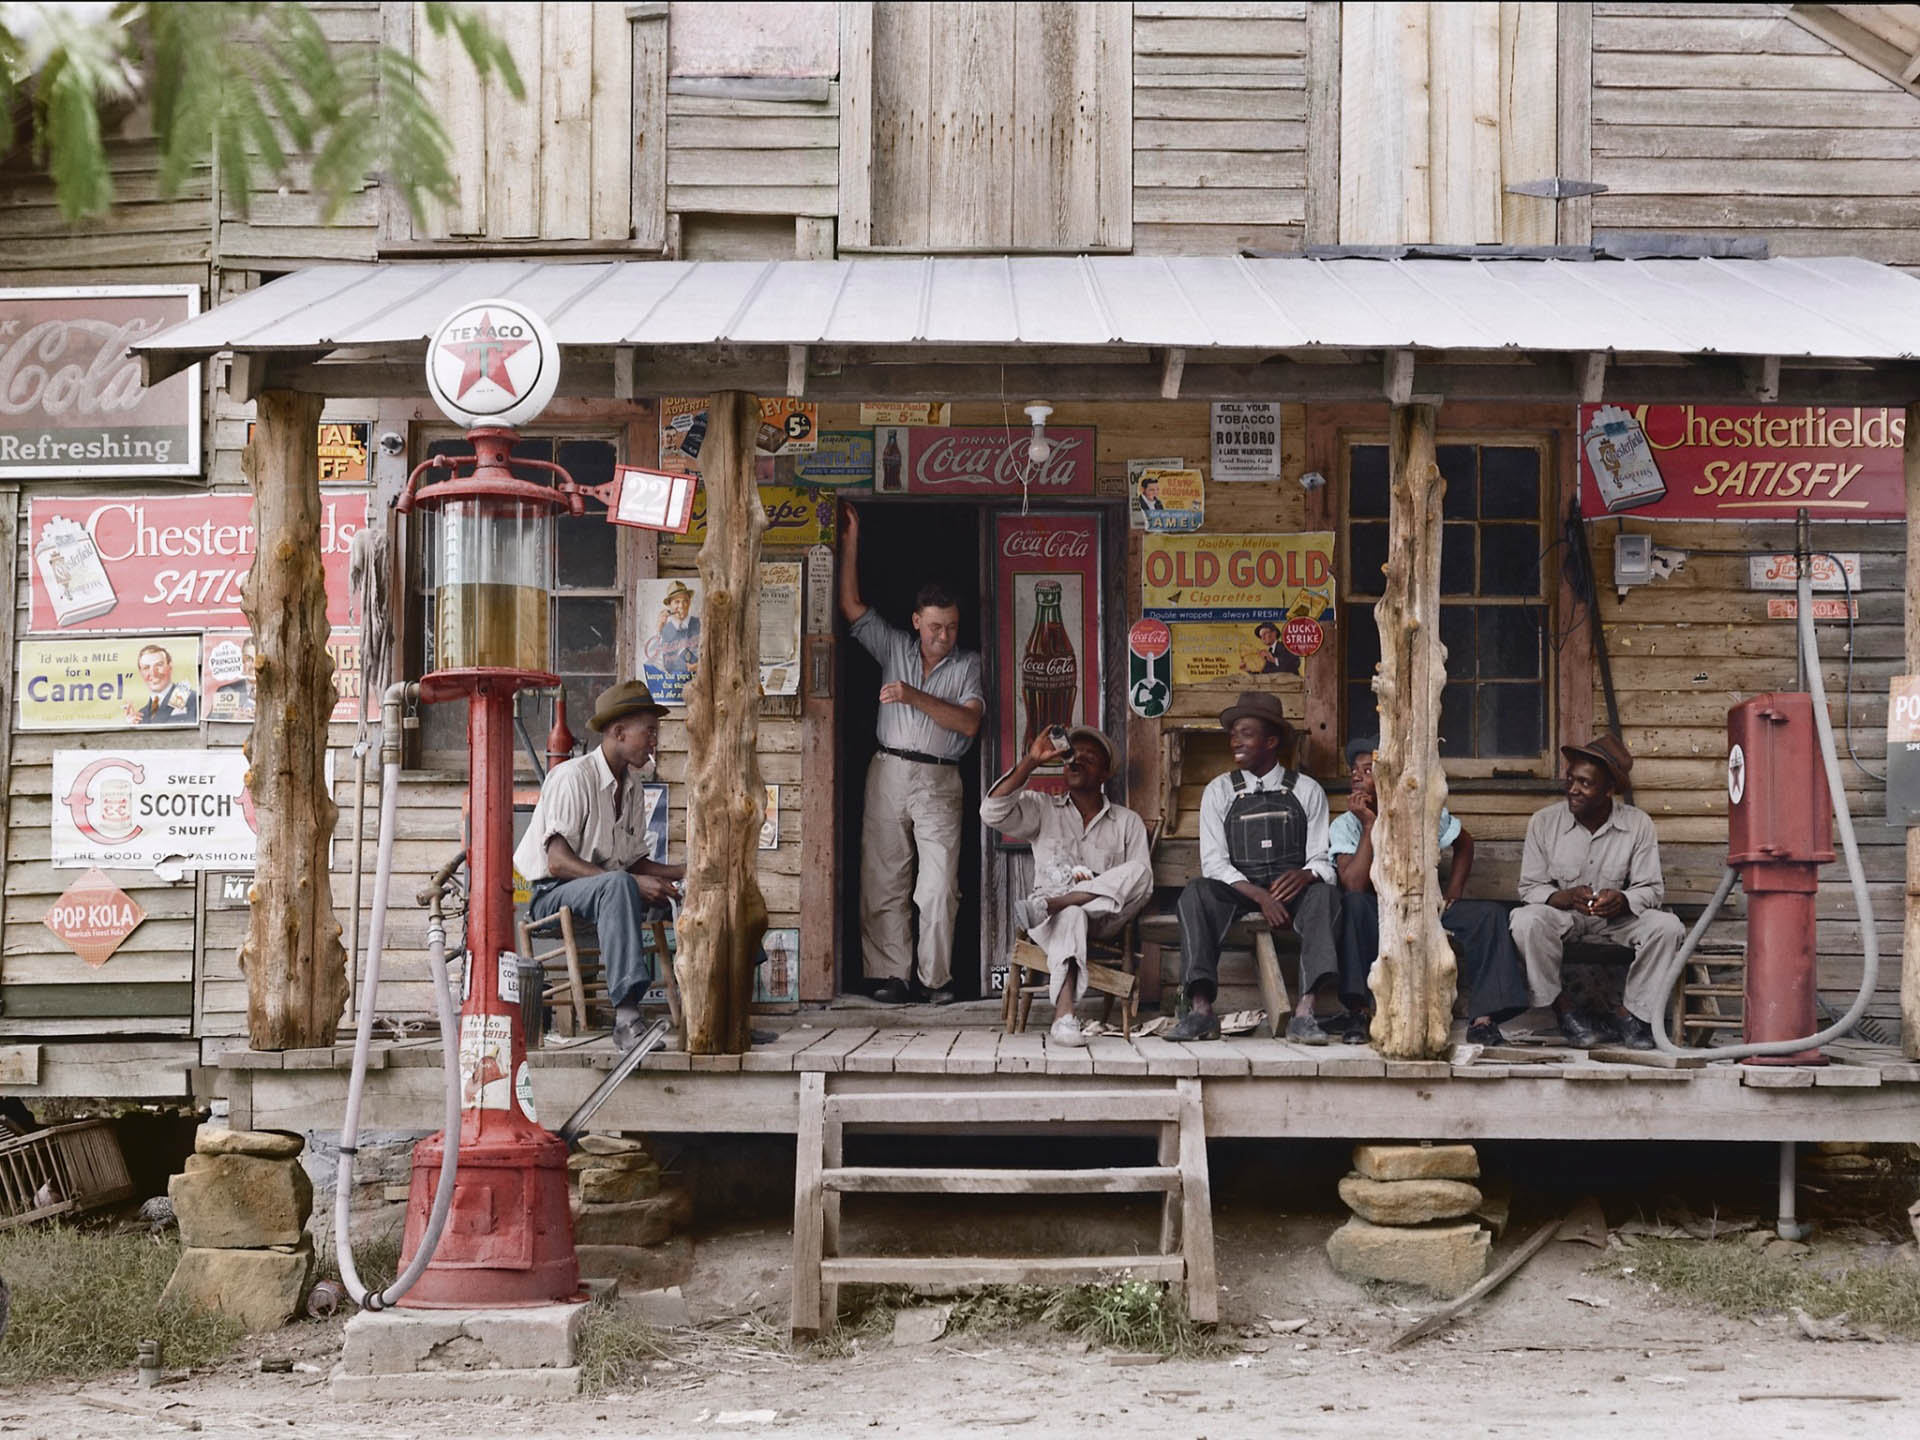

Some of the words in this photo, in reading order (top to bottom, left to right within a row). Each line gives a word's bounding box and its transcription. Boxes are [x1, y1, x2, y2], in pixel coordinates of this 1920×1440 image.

[451, 325, 523, 340] TEXACO
[665, 399, 711, 416] ADVERTIS
[1221, 404, 1243, 412] SELL
[1247, 404, 1270, 412] YOUR
[1216, 414, 1275, 424] TOBACCO
[1635, 404, 1906, 450] Chesterfields
[318, 424, 361, 445] TAL
[960, 436, 1008, 445] DRINK
[1216, 431, 1275, 445] ROXBORO
[2, 434, 172, 462] Refreshing
[1693, 461, 1865, 498] SATISFY
[86, 503, 356, 561] Chesterds
[1146, 550, 1221, 588] OLD
[1228, 550, 1331, 588] GOLD
[144, 569, 250, 604] SATIS
[1189, 590, 1262, 606] Cigarettes
[1150, 611, 1177, 619] Double
[1222, 611, 1250, 620] always
[1252, 611, 1284, 619] FRESH!
[1287, 624, 1317, 634] LUCKY
[1286, 634, 1320, 644] STRIKE
[56, 653, 79, 664] walk
[91, 653, 119, 663] MILE
[65, 666, 81, 677] for
[84, 668, 91, 677] a
[219, 693, 234, 702] 50
[1895, 694, 1920, 721] PO
[167, 775, 217, 785] SWEET
[139, 793, 231, 817] SCOTCH
[168, 826, 216, 836] SNUFF
[104, 852, 142, 861] GOOD
[188, 852, 257, 861] ASHIONE
[53, 906, 86, 930] POP
[88, 903, 134, 928] KOLA
